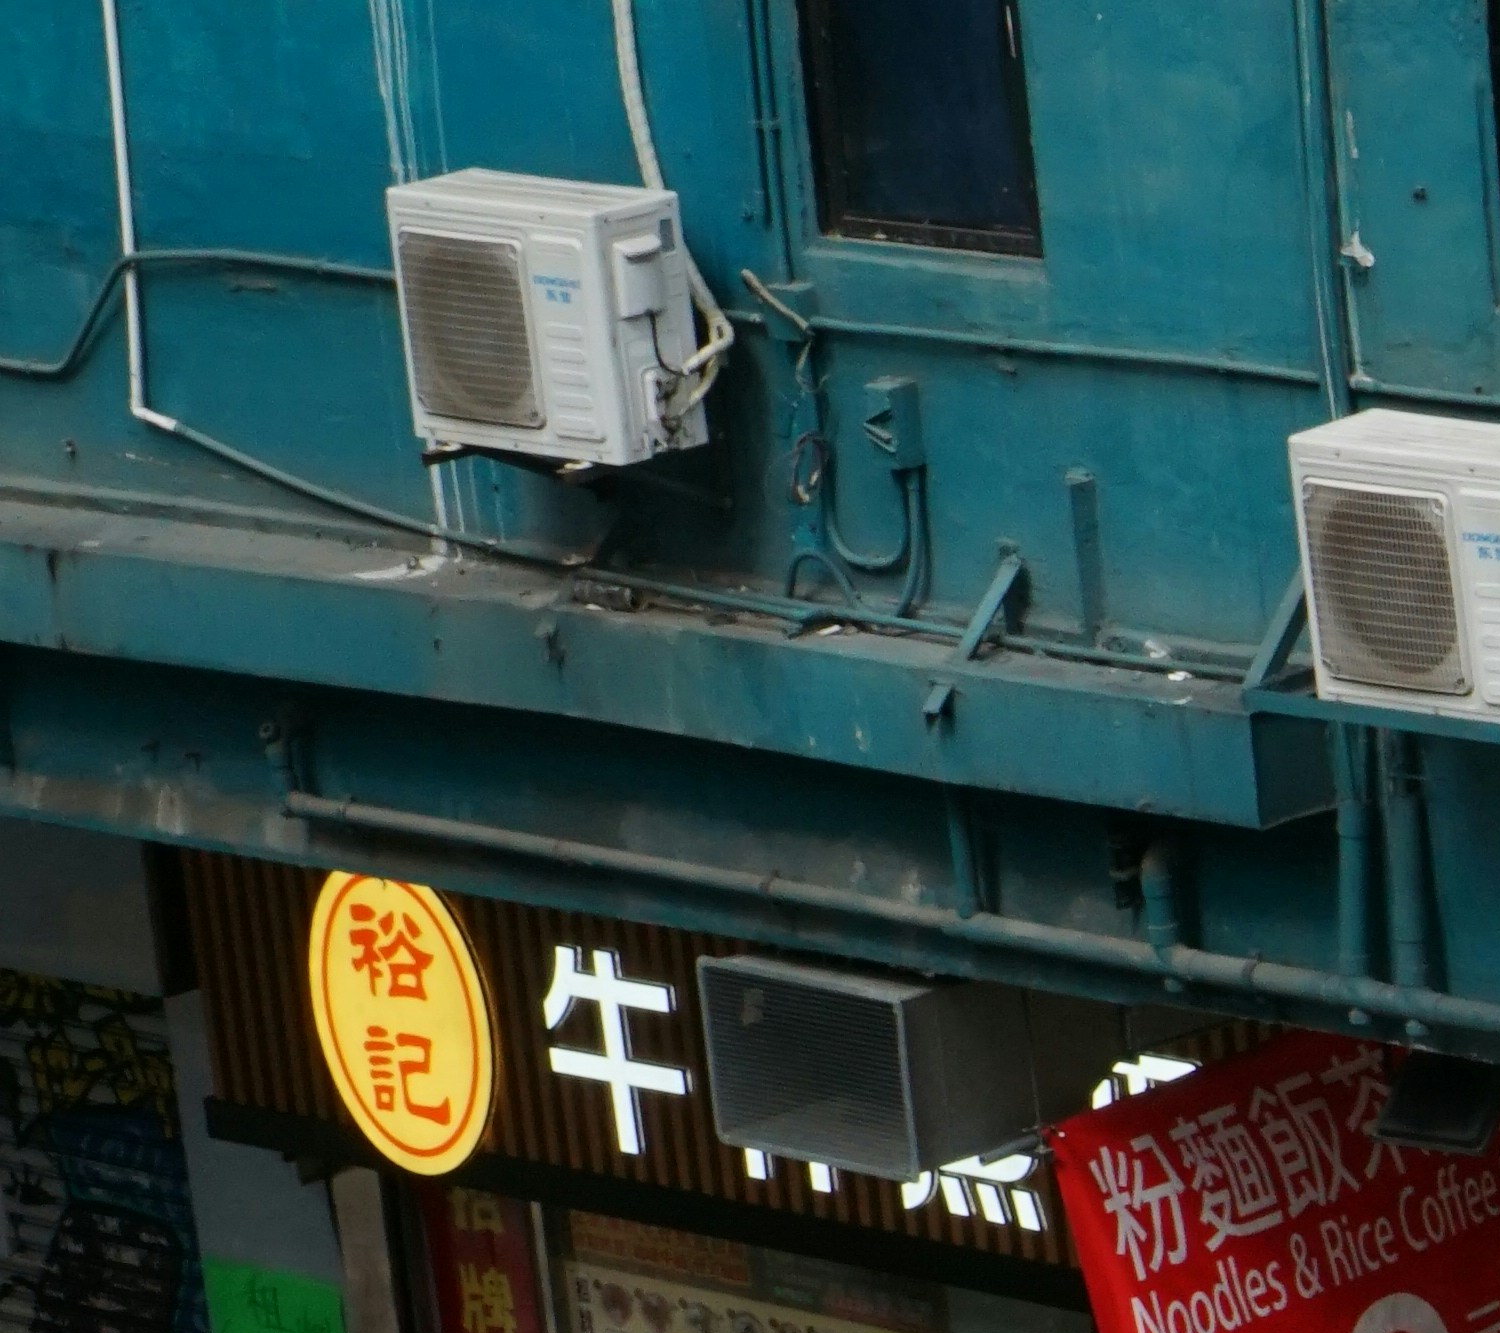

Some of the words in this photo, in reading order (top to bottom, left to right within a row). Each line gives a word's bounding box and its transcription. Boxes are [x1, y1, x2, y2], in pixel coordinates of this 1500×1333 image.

[349, 901, 453, 1127] 裕記
[1293, 1233, 1325, 1299] &
[1325, 1213, 1397, 1289] Rice
[1400, 1160, 1498, 1256] Coffee
